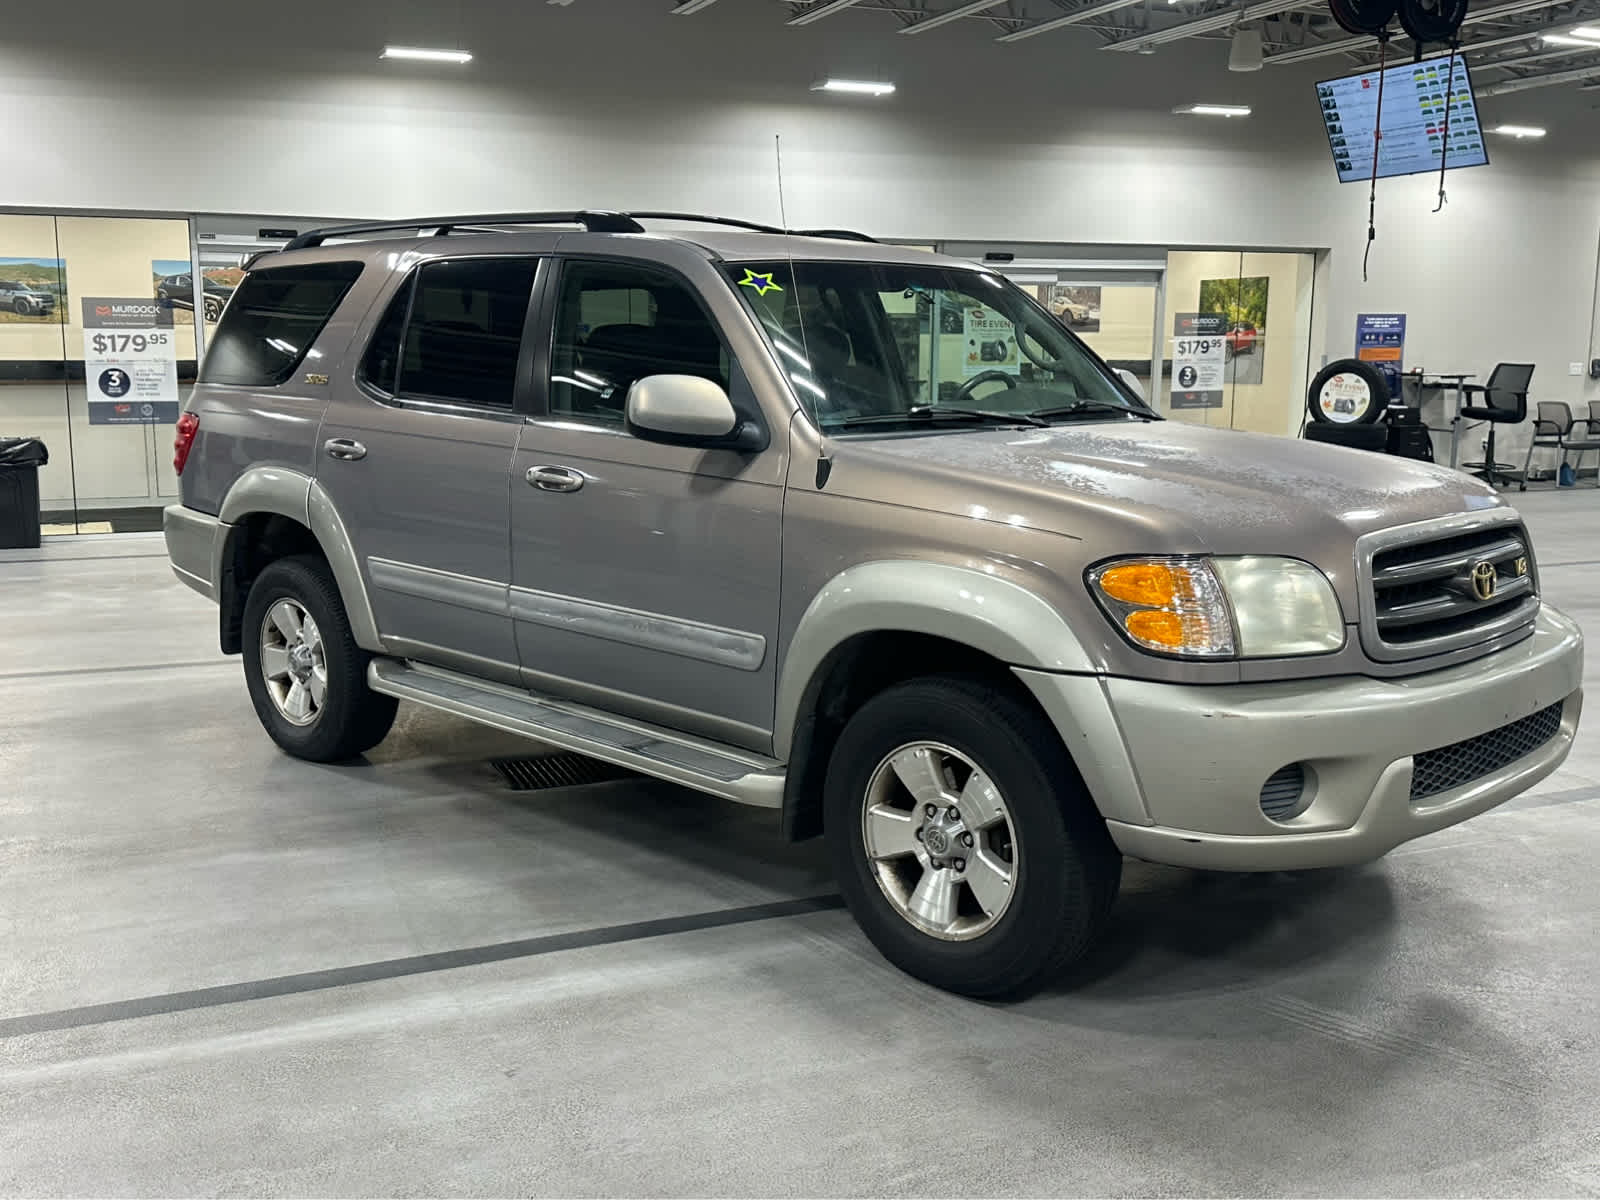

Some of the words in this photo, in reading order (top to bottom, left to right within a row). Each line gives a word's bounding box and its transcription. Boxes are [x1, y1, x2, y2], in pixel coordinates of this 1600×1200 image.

[111, 305, 160, 314] MURDOCK
[108, 371, 120, 386] 3
[1183, 368, 1192, 380] 3
